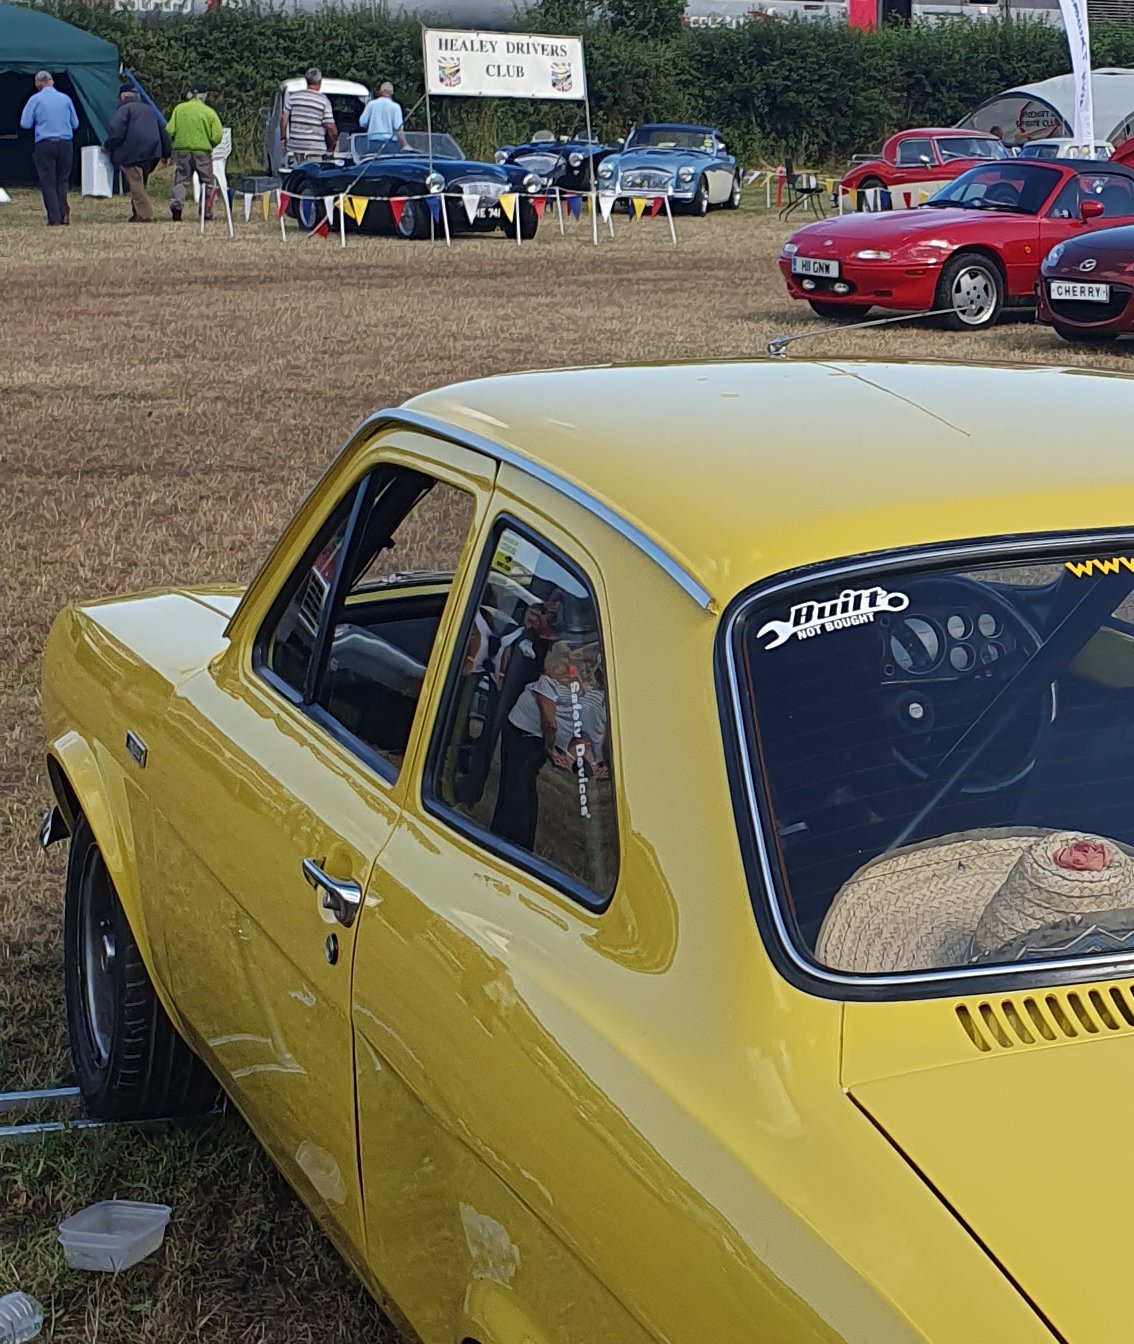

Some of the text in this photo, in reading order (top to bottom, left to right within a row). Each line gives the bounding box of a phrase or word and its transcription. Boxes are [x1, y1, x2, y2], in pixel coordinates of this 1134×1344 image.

[438, 38, 568, 57] HEALEY DRIVERS
[485, 64, 525, 78] CLUB
[1057, 286, 1101, 297] CHERRY
[792, 589, 886, 628] Built
[797, 612, 875, 641] NOT BOUGHT
[569, 680, 583, 739] Safety
